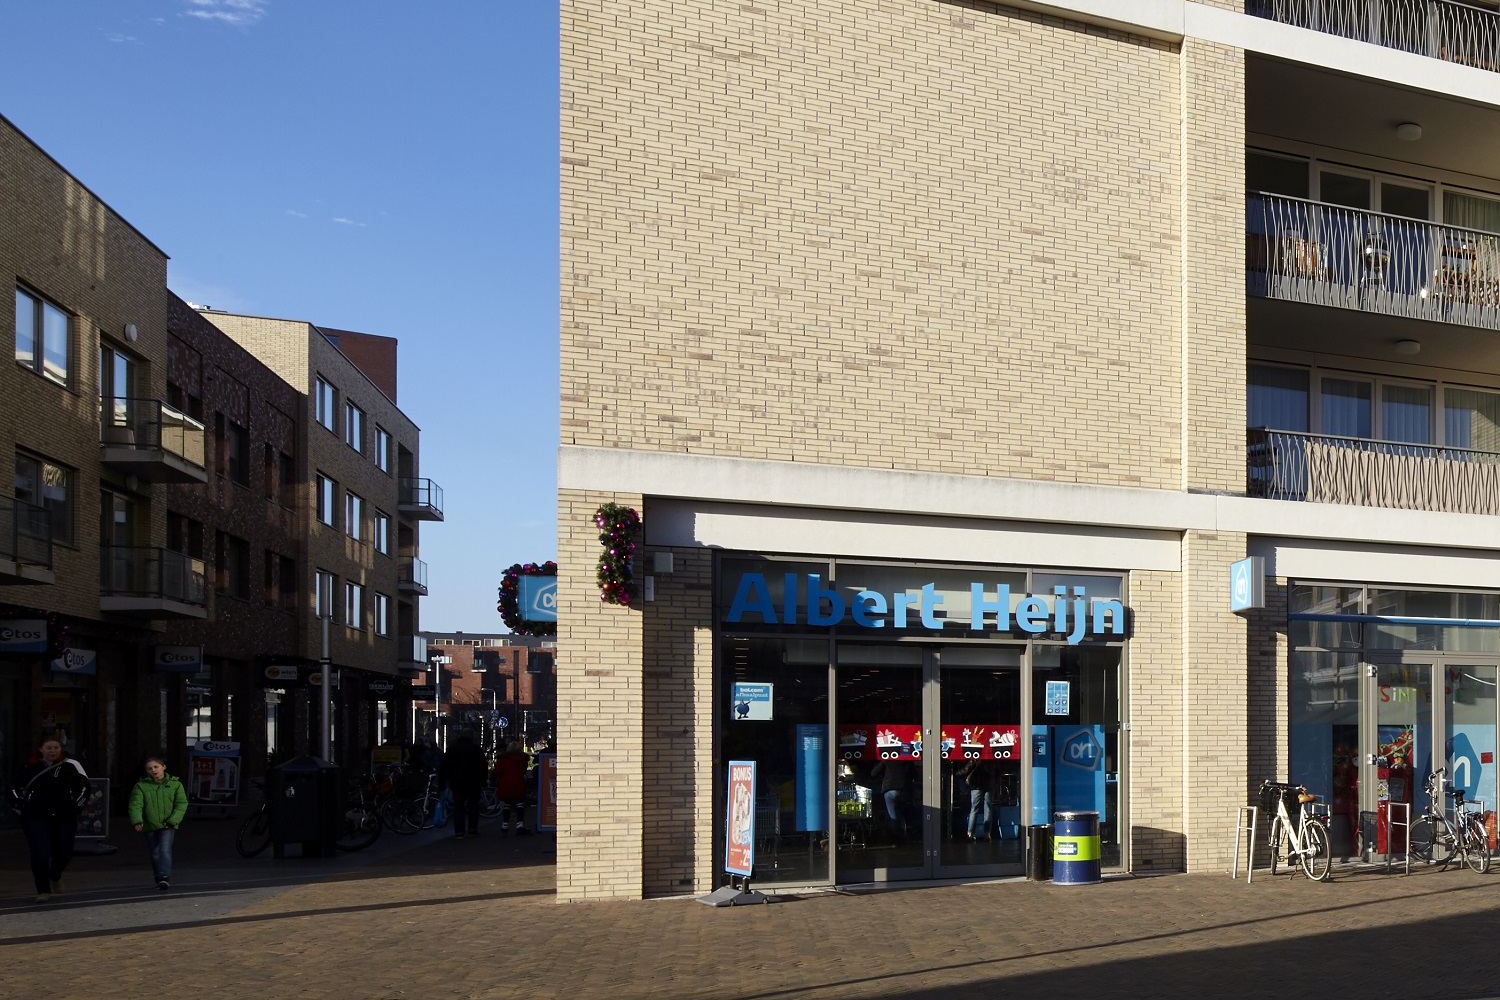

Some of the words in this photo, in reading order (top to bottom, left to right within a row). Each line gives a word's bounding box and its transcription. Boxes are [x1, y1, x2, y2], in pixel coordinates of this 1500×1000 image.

[726, 572, 944, 630] Albert
[971, 581, 1124, 645] Heijn
[733, 766, 752, 781] BONUS
